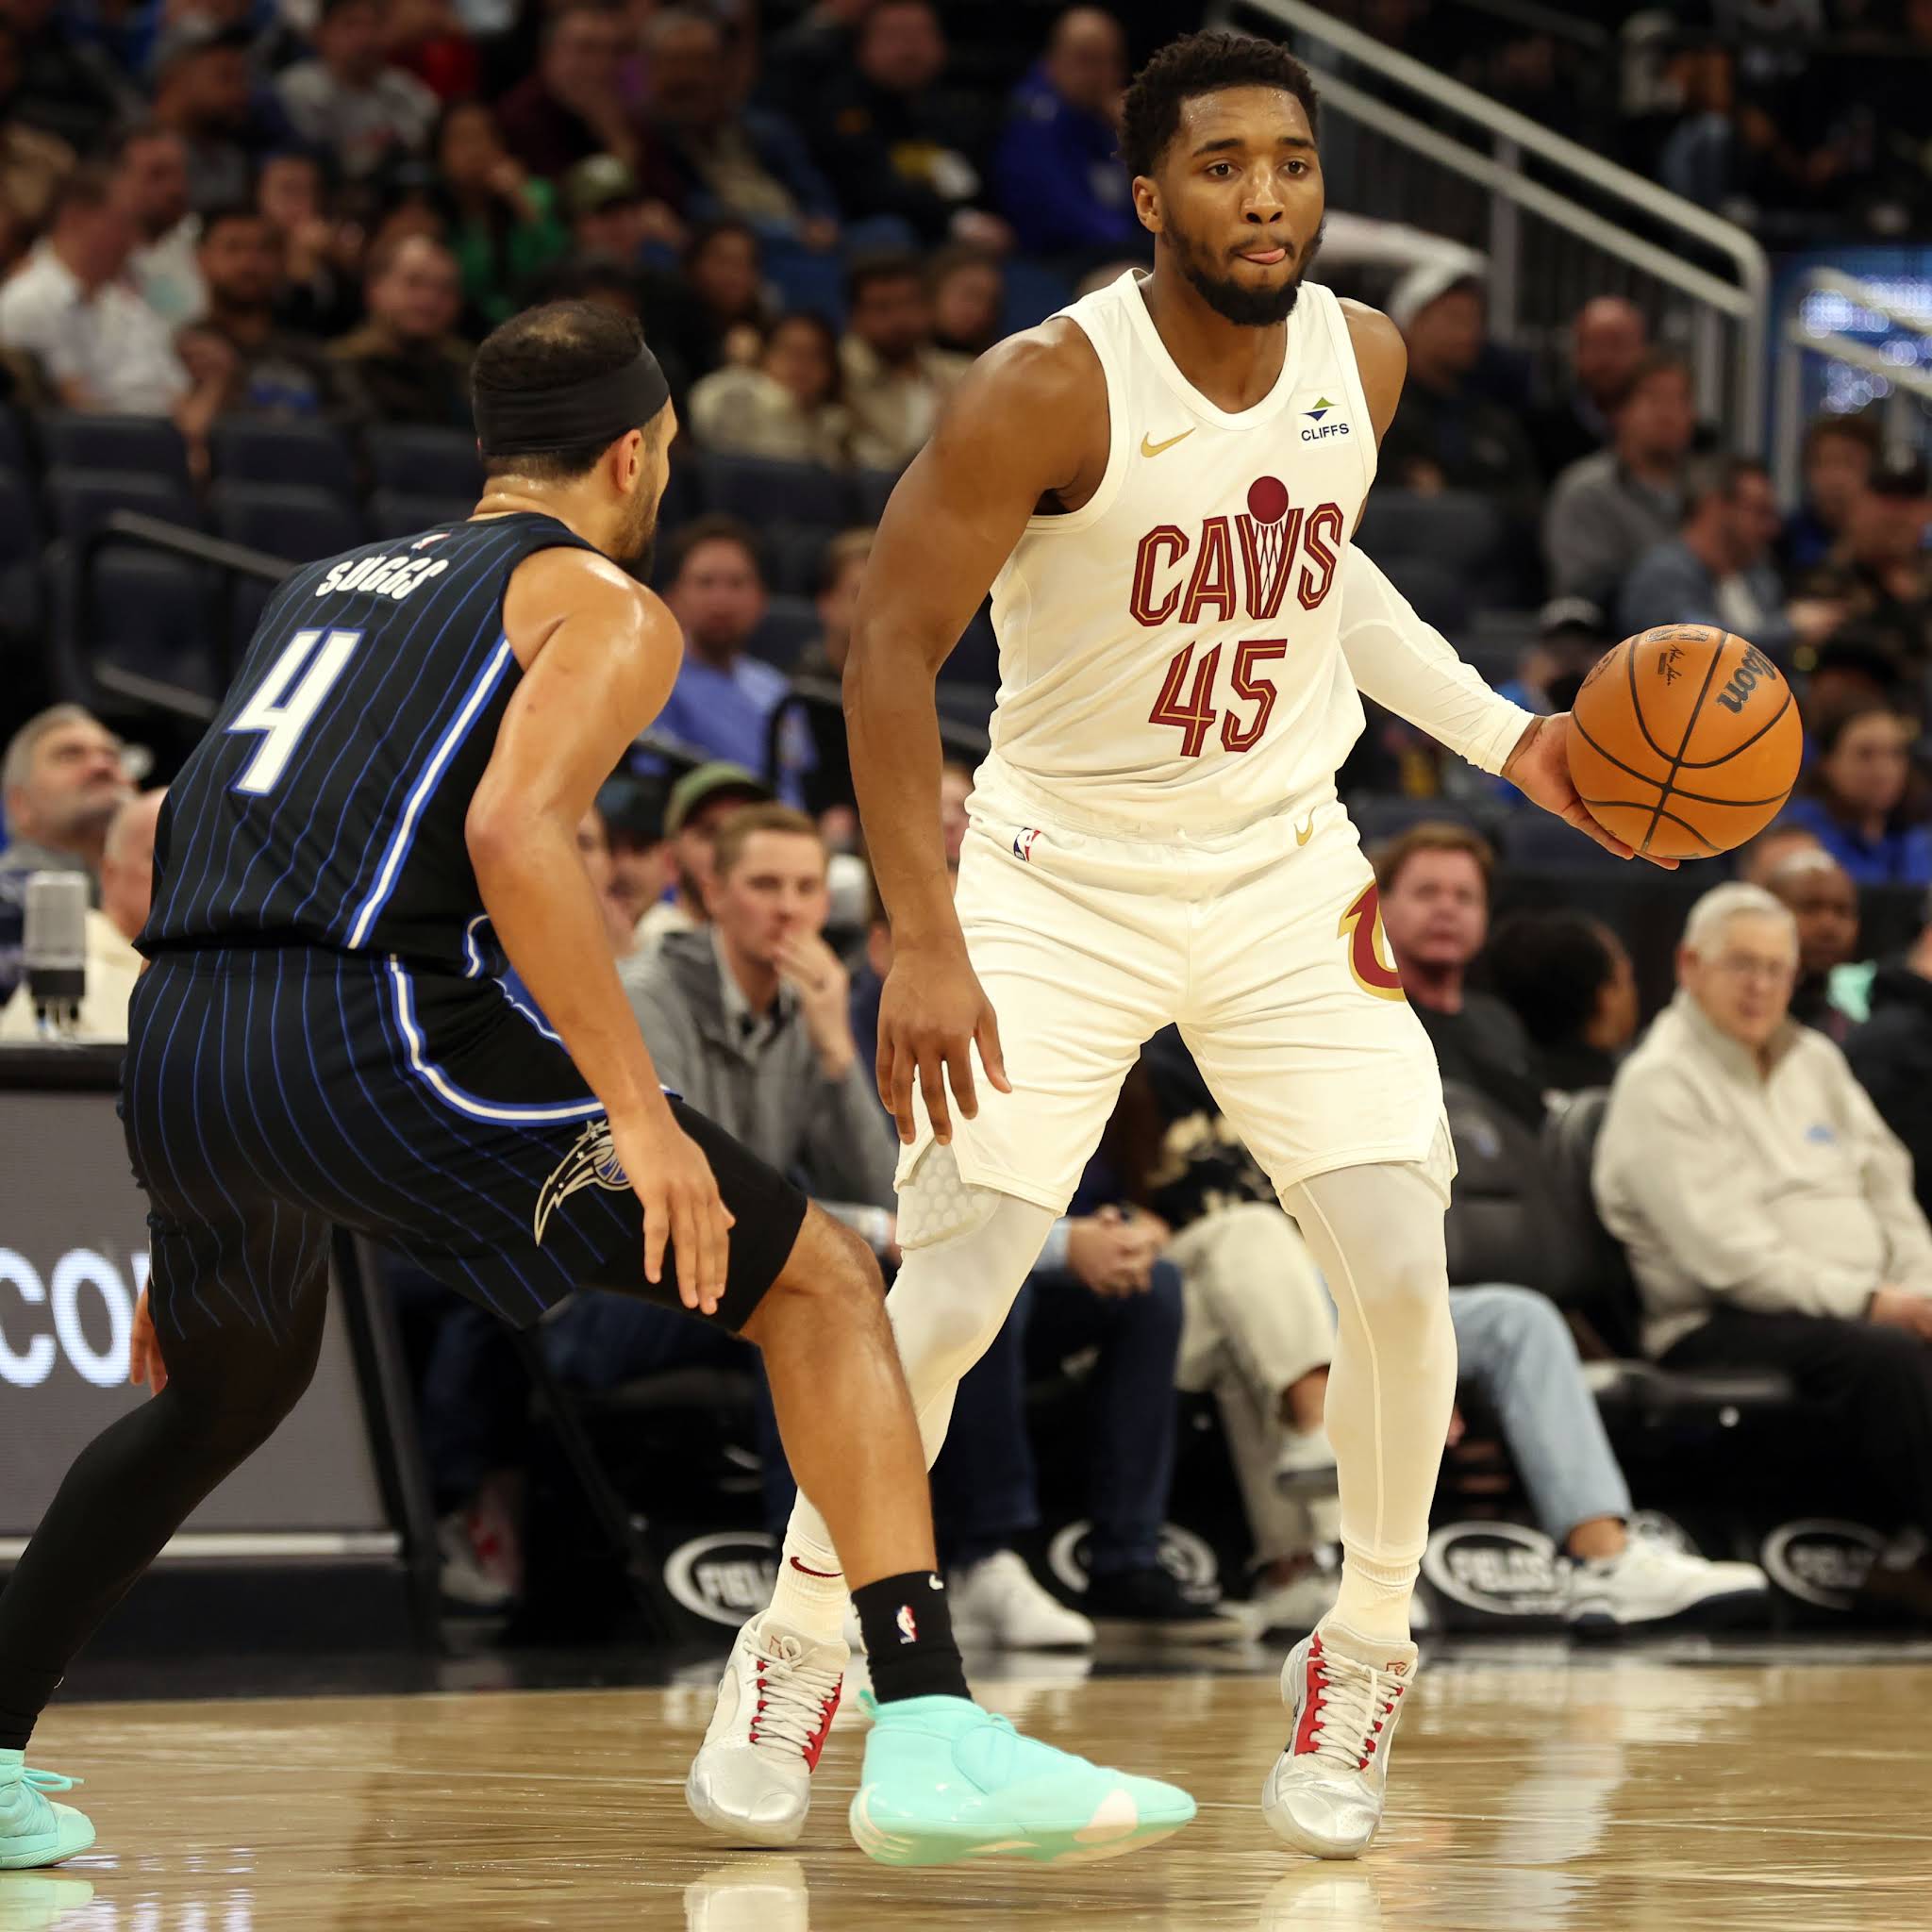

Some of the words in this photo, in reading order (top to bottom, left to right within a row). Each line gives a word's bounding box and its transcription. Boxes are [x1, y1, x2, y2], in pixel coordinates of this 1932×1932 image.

[1301, 423, 1349, 441] CLIFFS
[315, 556, 449, 600] SUGGS
[1129, 502, 1344, 626] CAVS
[224, 627, 366, 796] 4
[1149, 639, 1288, 758] 45
[1716, 643, 1776, 713] lson
